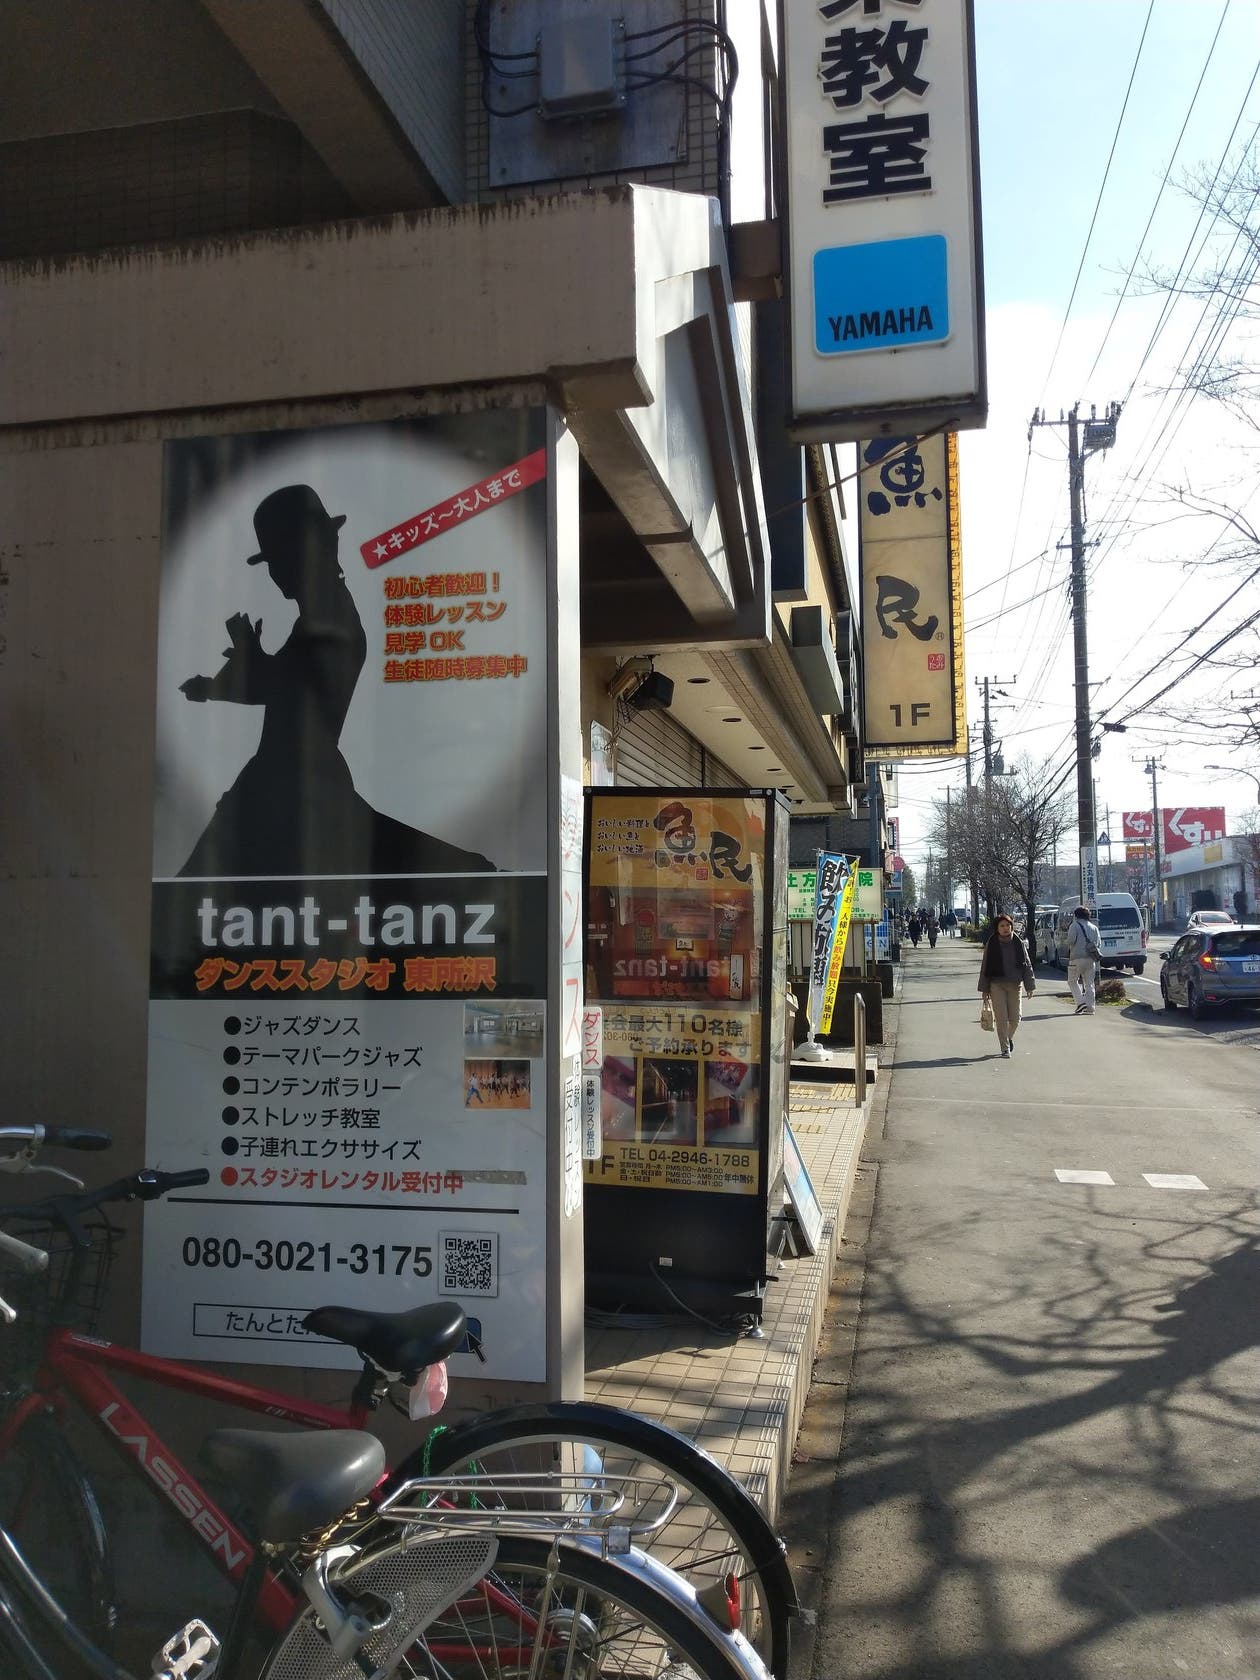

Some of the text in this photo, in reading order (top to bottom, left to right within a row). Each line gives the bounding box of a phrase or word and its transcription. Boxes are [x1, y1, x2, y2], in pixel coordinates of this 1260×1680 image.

[818, 0, 932, 203] 教室
[828, 304, 934, 342] YAMAHA
[384, 600, 507, 627] 体験レッスン
[384, 631, 466, 655] 見学 OK
[384, 655, 528, 683] 生徒随時募集中
[889, 703, 931, 728] 1F
[653, 801, 753, 883] 魚民
[197, 896, 496, 946] tant-tanz
[194, 957, 497, 991] ダンススタジオ 東所沢
[243, 1016, 361, 1036] ジャズダンス
[584, 1011, 602, 1065] ダンス
[243, 1046, 423, 1067] テーマパークジャズ
[629, 1037, 752, 1056] ご予約承ります
[243, 1077, 401, 1098] コンテンポラリー
[242, 1107, 380, 1129] ストレッチ教室
[240, 1137, 422, 1160] 子連れエクササイズ
[620, 1148, 750, 1168] TEL 04-2946-1788
[240, 1167, 463, 1194] スタジオレンタル受付中
[182, 1236, 432, 1277] 080-3021-3175
[225, 1311, 320, 1336] たんとた
[100, 1402, 245, 1571] LASSEN
